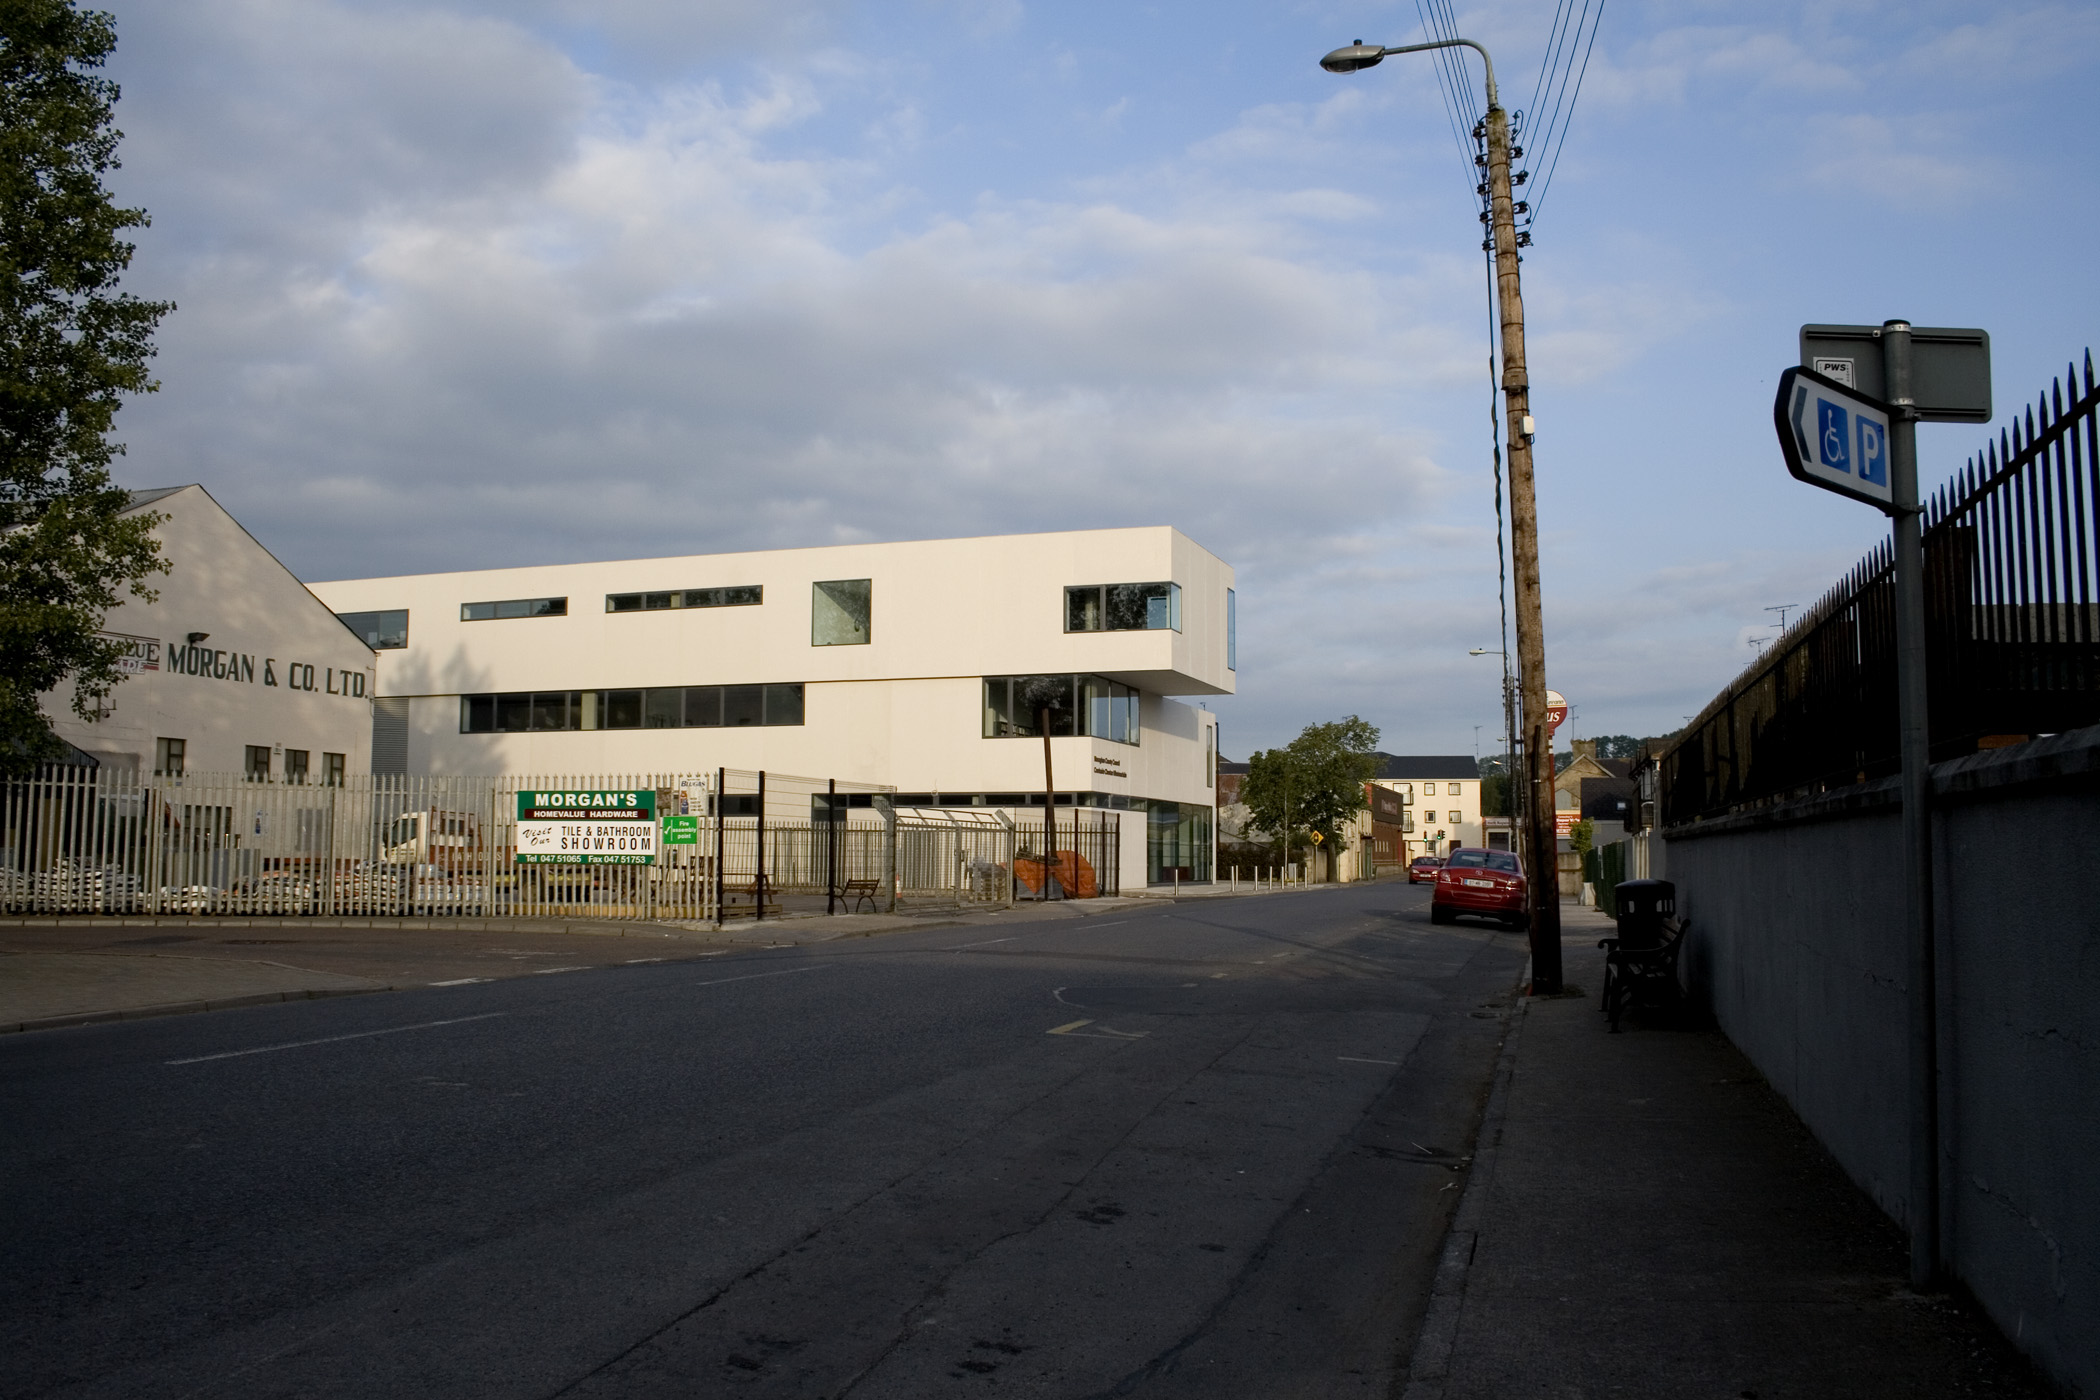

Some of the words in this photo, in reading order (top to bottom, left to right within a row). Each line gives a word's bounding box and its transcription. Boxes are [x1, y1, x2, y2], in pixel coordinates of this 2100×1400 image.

[1824, 363, 1846, 371] PWS
[1862, 423, 1878, 475] P
[167, 642, 255, 683] MORGAN
[264, 658, 279, 687] &
[289, 662, 318, 692] CO.
[326, 667, 368, 699] LTD.
[1546, 711, 1561, 723] us
[535, 793, 638, 807] MORGAN'S
[533, 810, 586, 818] HOMEVALUE
[589, 810, 639, 818] HARDWARE
[522, 827, 552, 838] Visit
[561, 825, 582, 836] TILE
[586, 825, 593, 836] &
[596, 826, 651, 837] BATHROOM
[530, 836, 551, 846] Our
[561, 837, 651, 850] SHOWROOM
[525, 854, 538, 863] Tel
[540, 855, 556, 863] 047
[588, 855, 602, 863] Fax
[603, 855, 620, 863] 047
